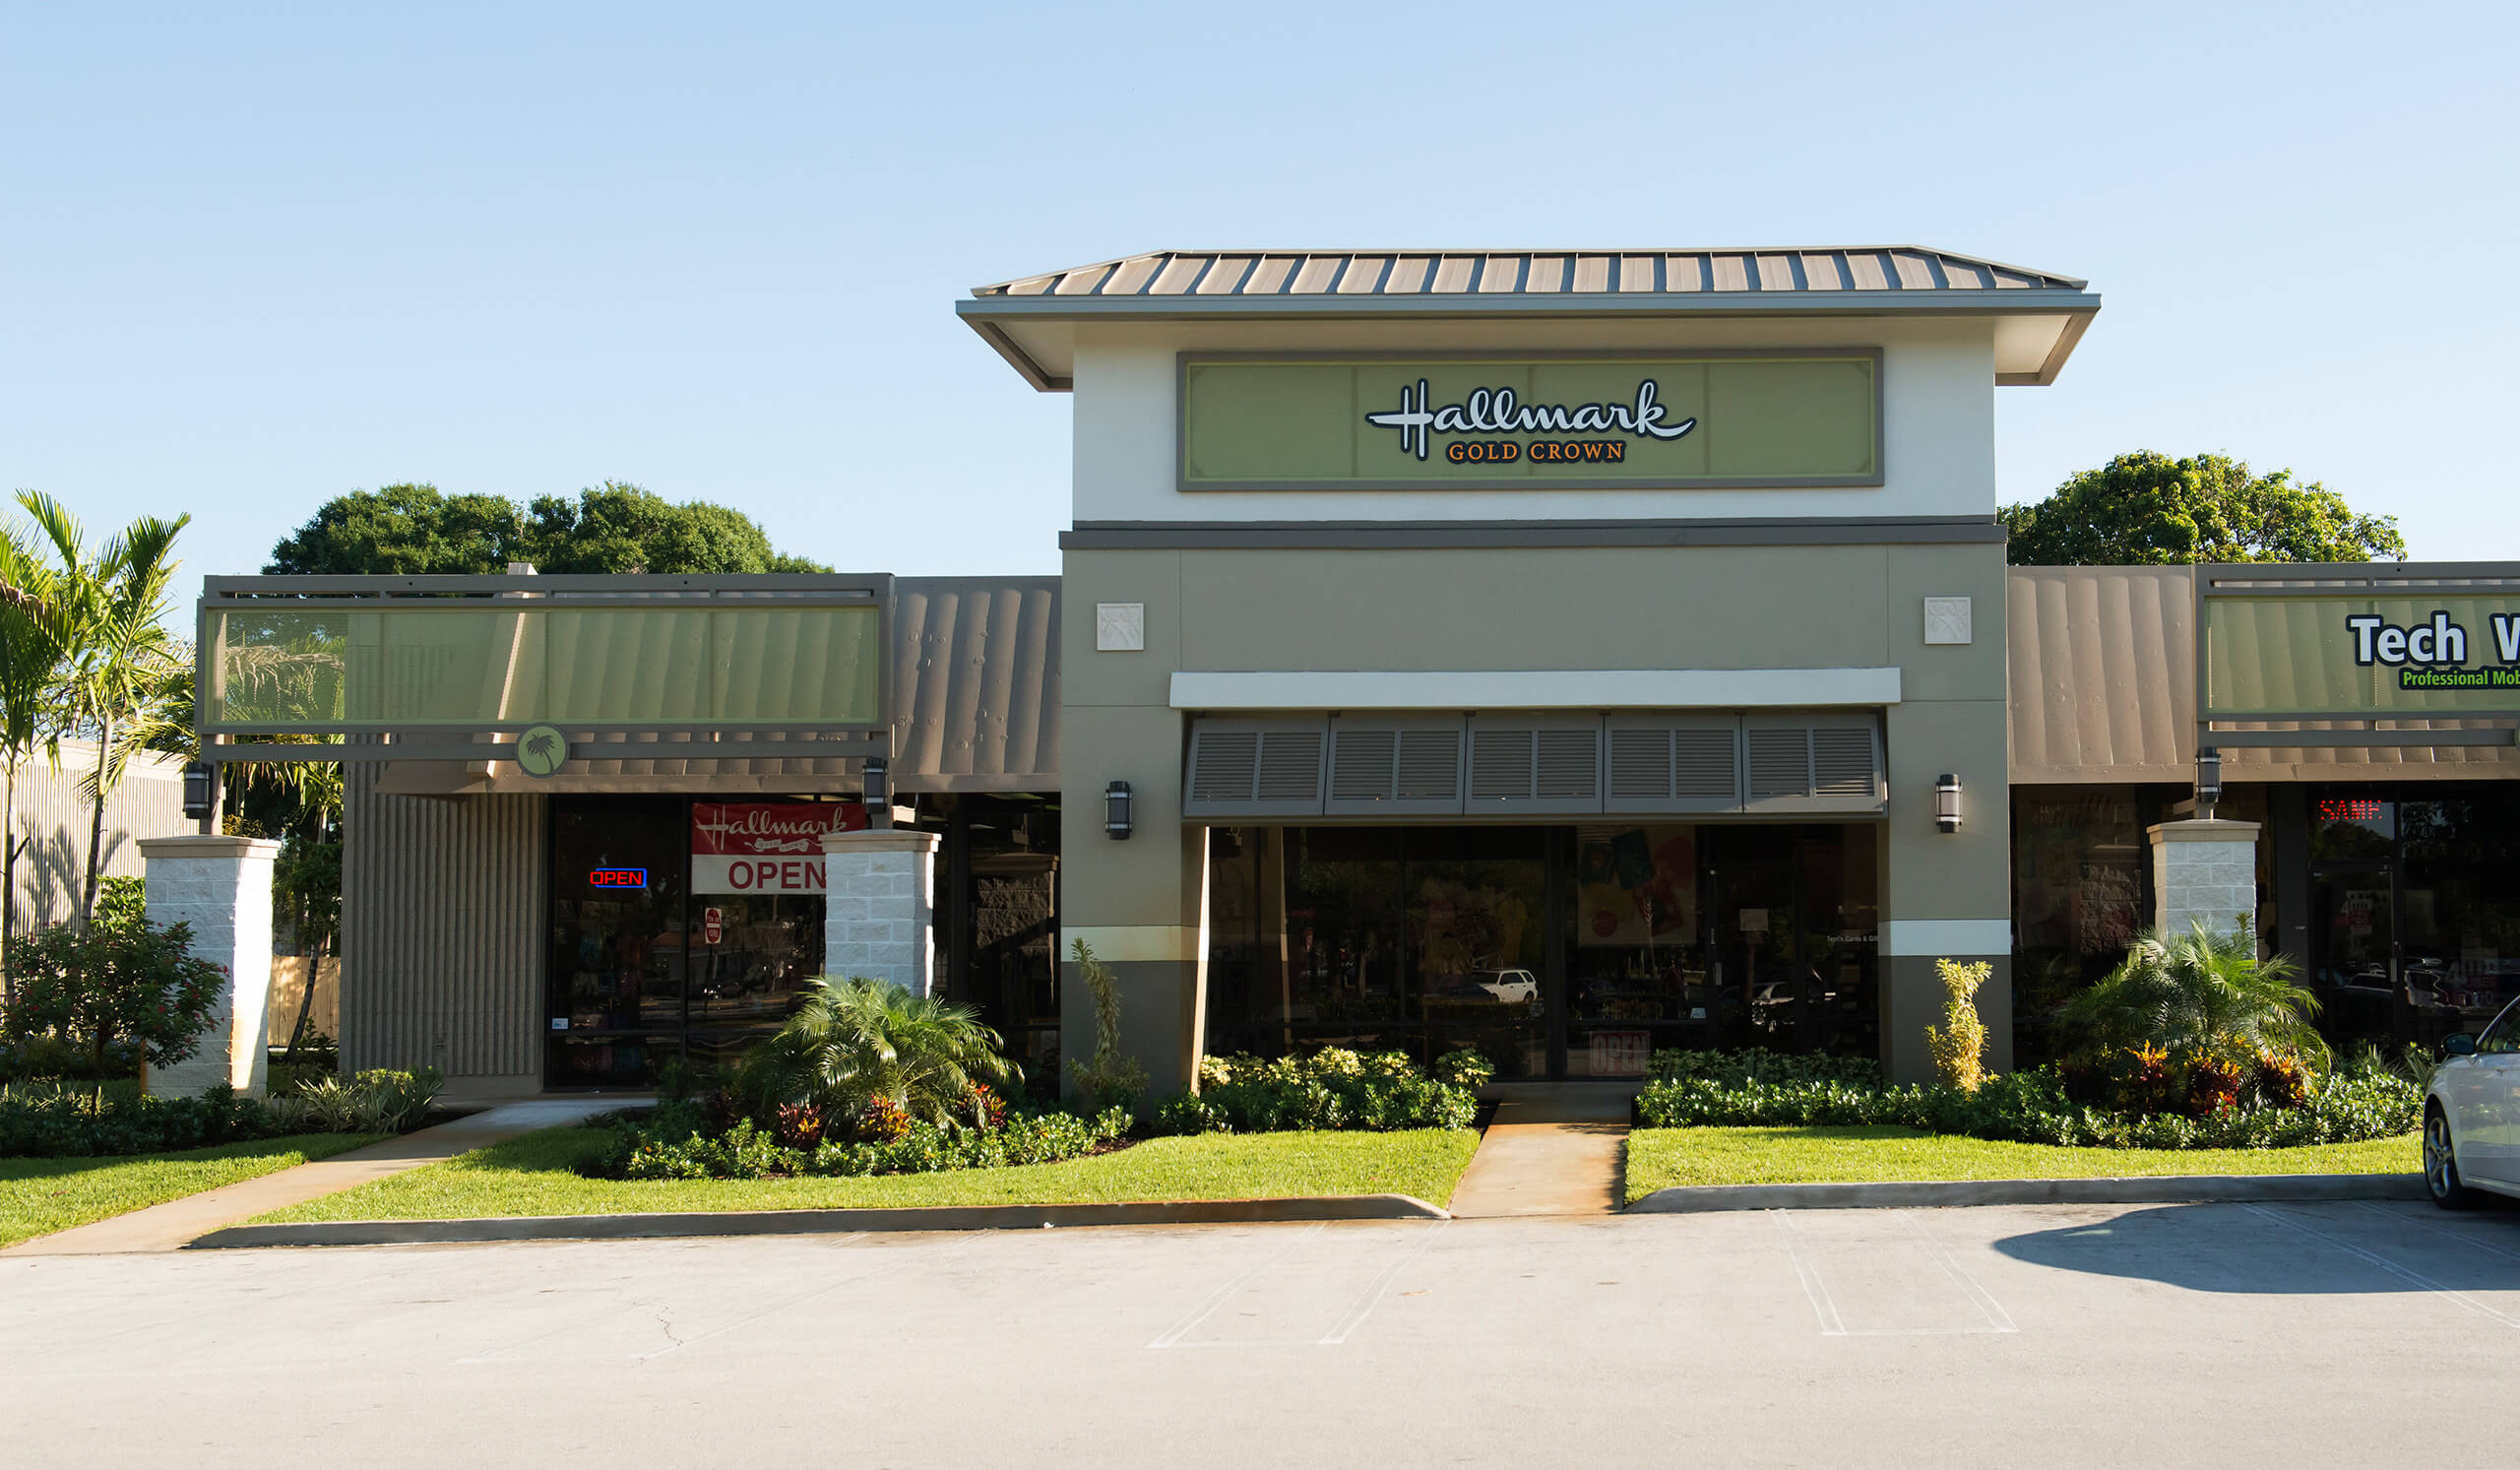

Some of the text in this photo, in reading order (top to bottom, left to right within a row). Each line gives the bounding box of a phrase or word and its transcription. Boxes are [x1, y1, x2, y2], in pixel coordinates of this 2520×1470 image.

[1367, 379, 1694, 459] Hallmark
[1448, 442, 1624, 461] GOLD CROWN
[2349, 612, 2466, 664] Tech
[2402, 669, 2489, 687] Professional
[695, 804, 848, 852] Hallmark
[590, 870, 643, 886] OPEN
[728, 861, 827, 890] OPEN
[1592, 1035, 1647, 1072] OPEN
